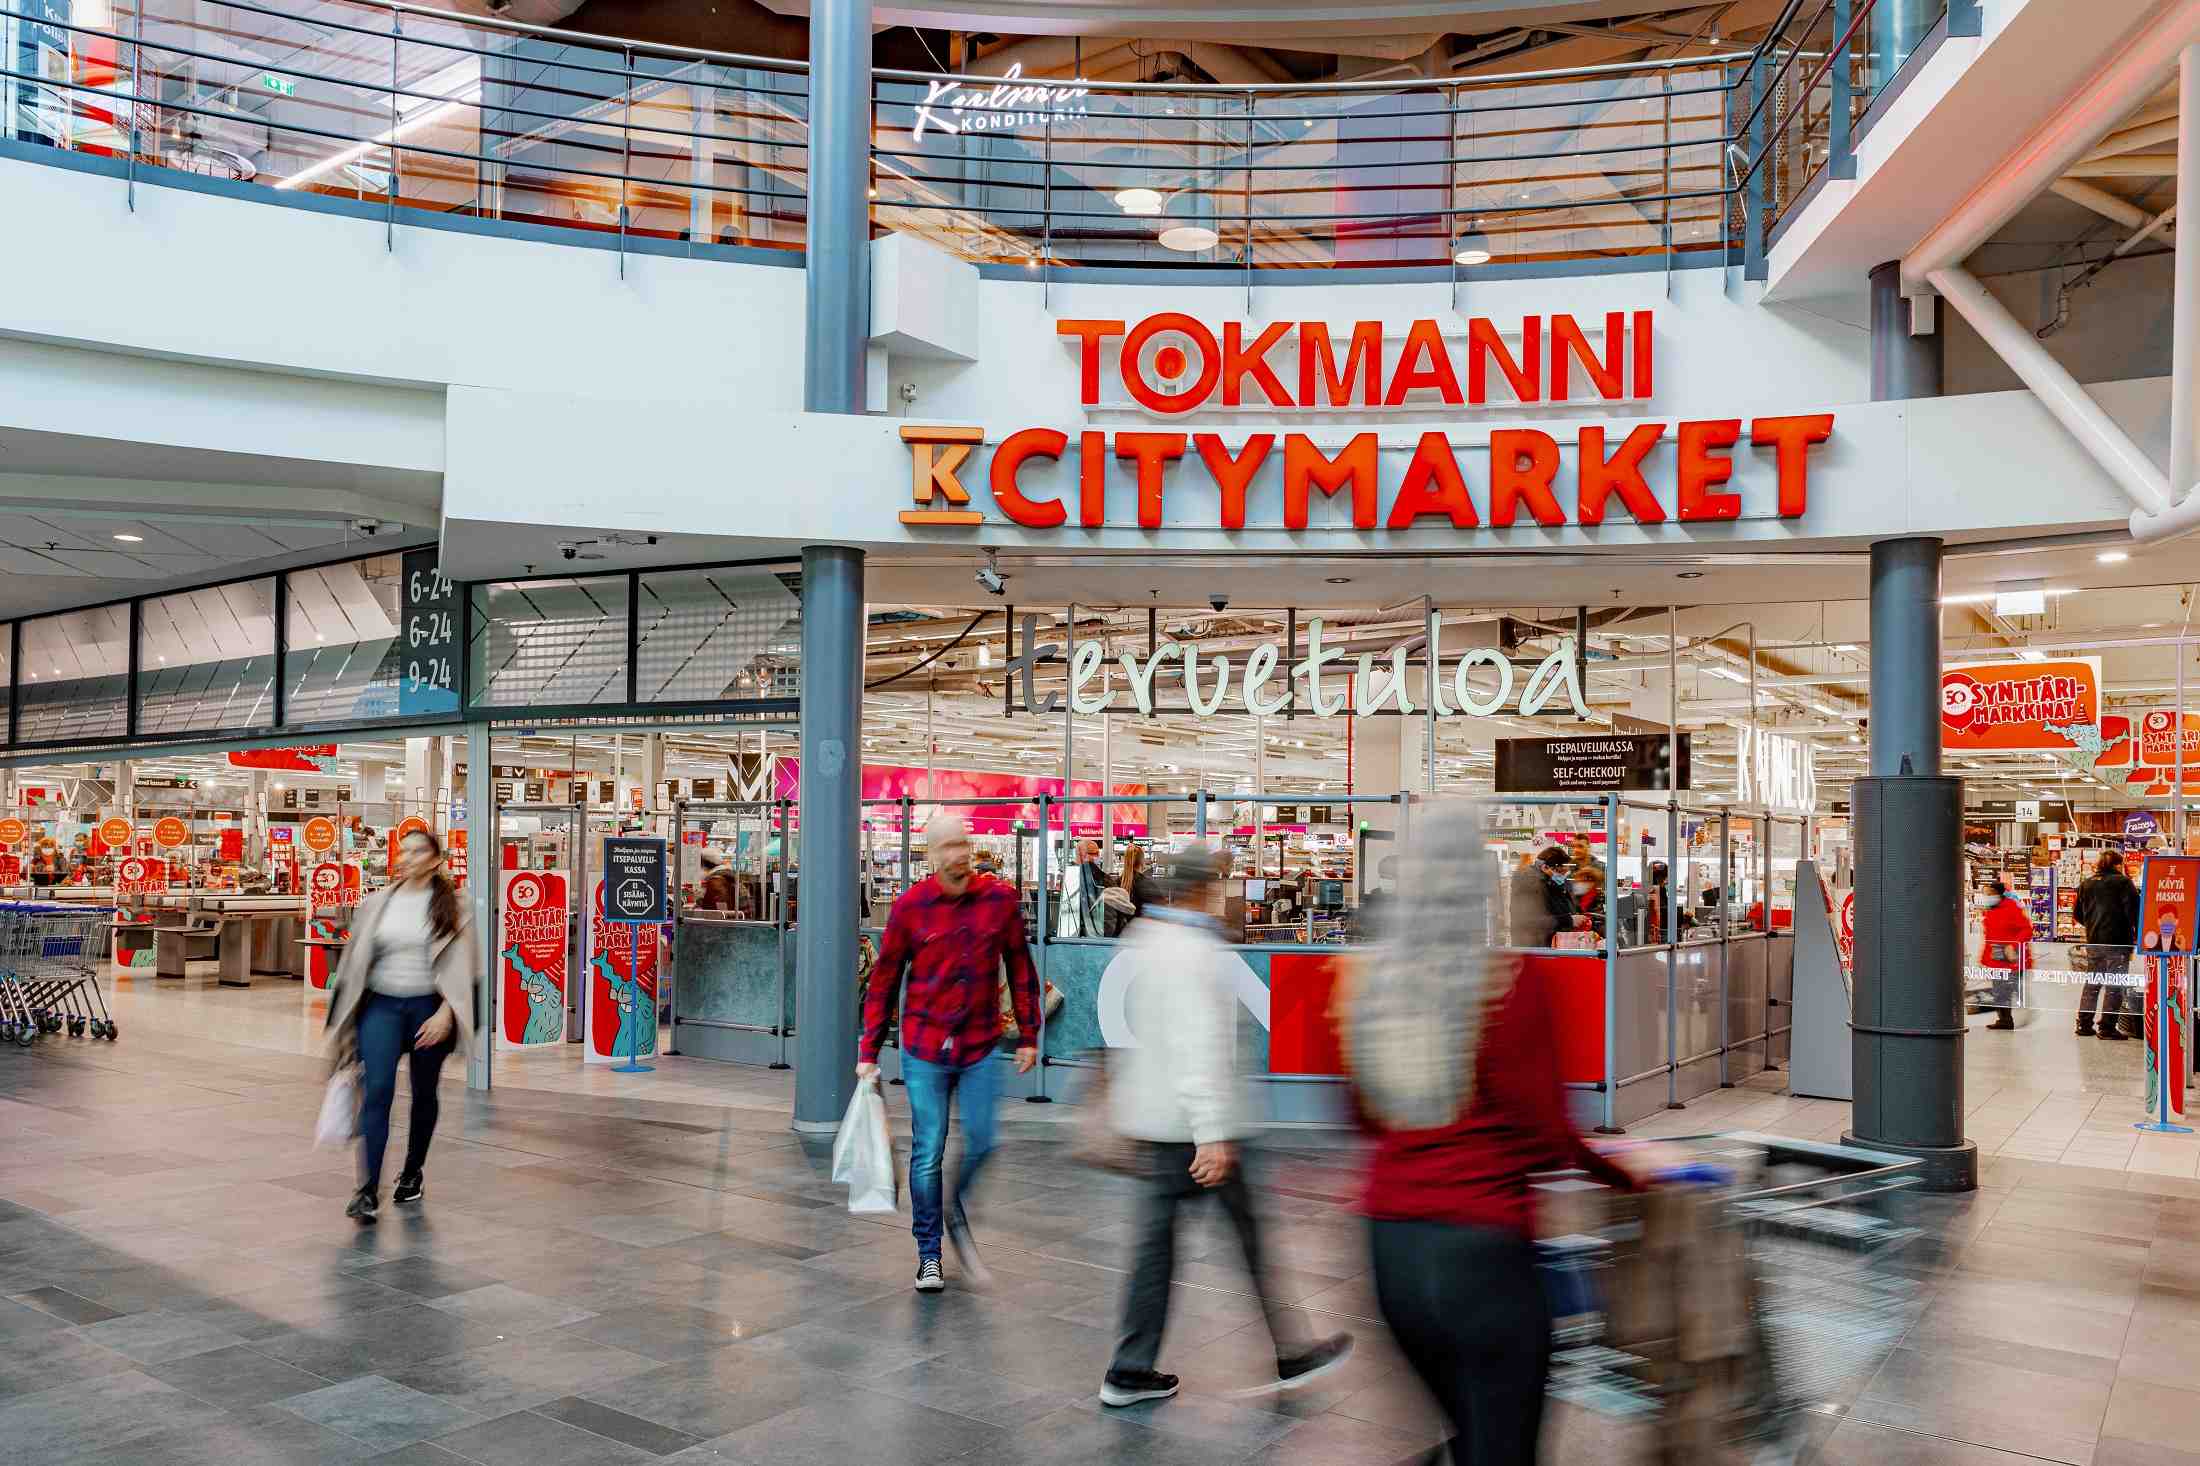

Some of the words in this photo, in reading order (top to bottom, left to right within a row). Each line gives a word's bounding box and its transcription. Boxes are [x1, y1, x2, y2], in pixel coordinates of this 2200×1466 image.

[1056, 309, 1654, 415] TOKMANNI
[989, 413, 1836, 531] CITYMARKET
[410, 567, 453, 603] 6-24
[409, 612, 452, 648] 6-24
[408, 656, 452, 693] 9-24
[1005, 611, 1592, 716] tervetuloa
[1970, 673, 2088, 705] SYNTTÄRI-
[1973, 699, 2077, 725] MARKKINAT
[1546, 740, 1634, 755] ITSEPALVELUKASSA
[1553, 766, 1627, 779] SELF-CHECKOUT
[613, 855, 658, 864] ITSEPALVELU-
[624, 865, 647, 874] KASSA
[505, 924, 564, 943] MARKKINAT
